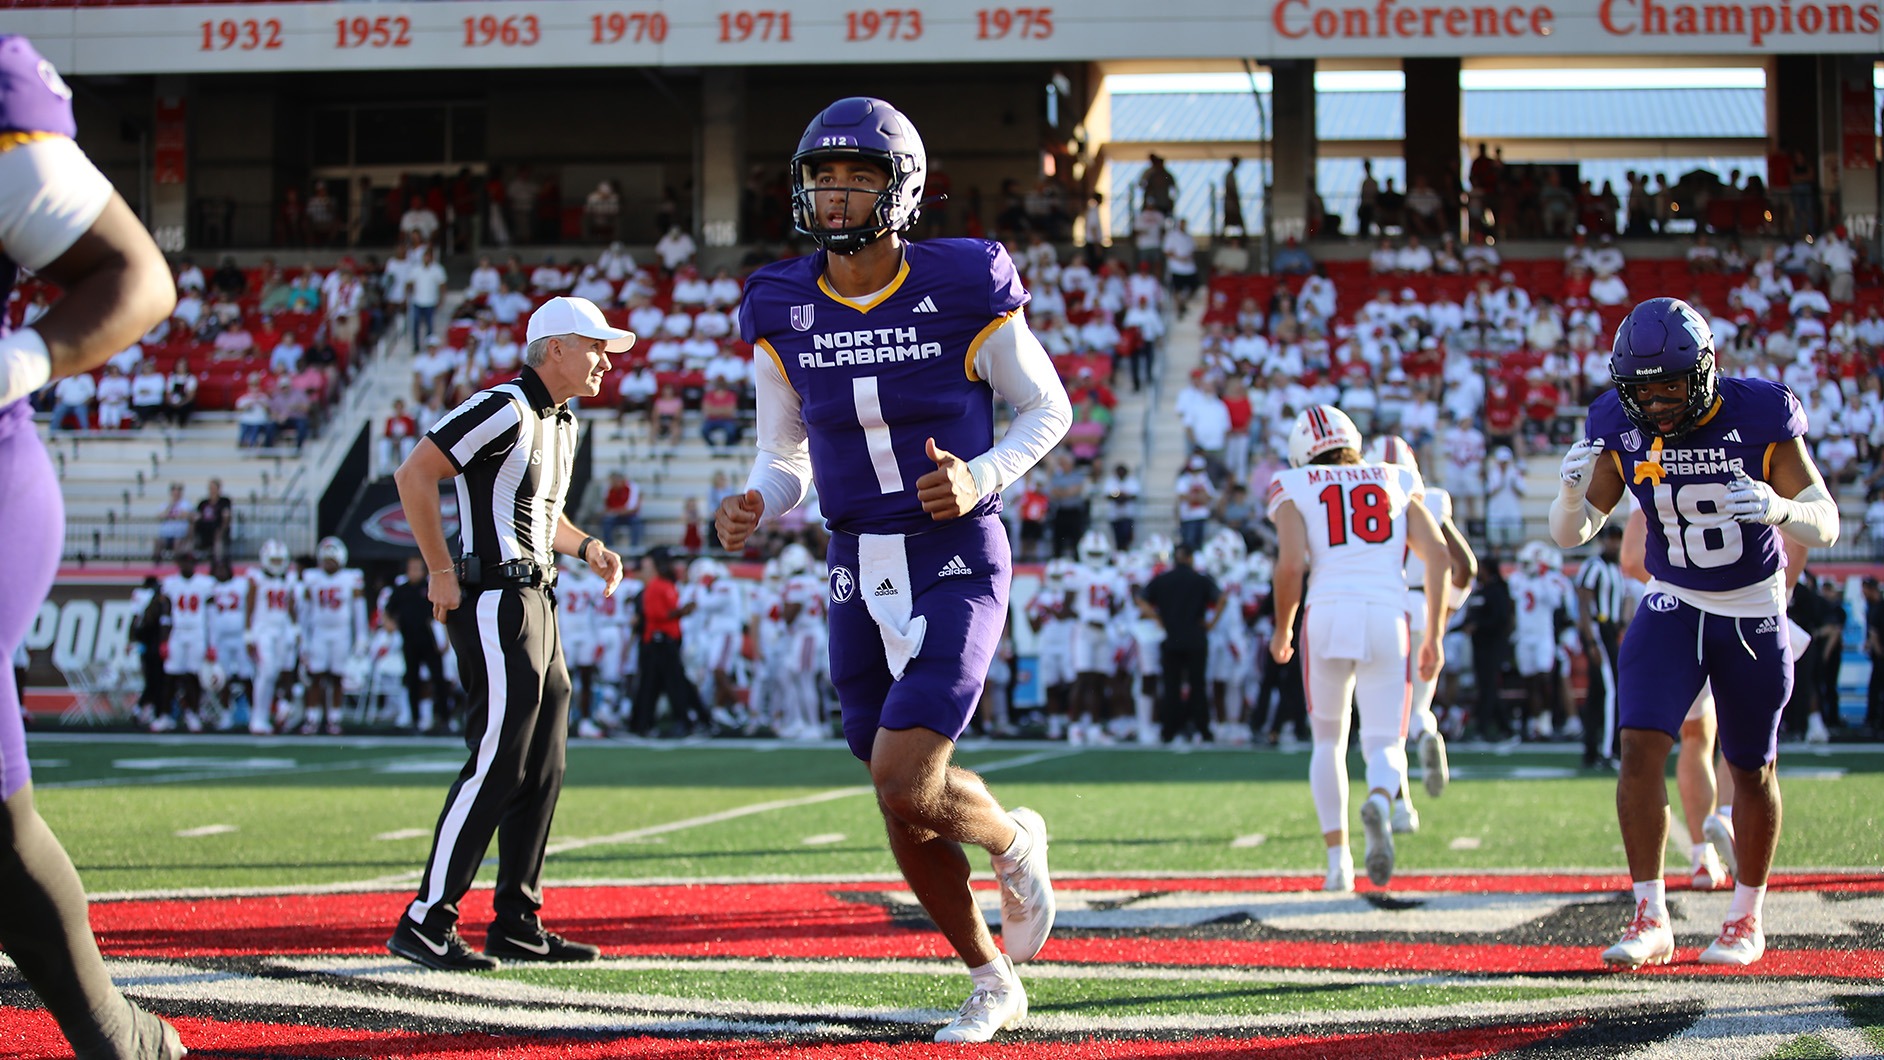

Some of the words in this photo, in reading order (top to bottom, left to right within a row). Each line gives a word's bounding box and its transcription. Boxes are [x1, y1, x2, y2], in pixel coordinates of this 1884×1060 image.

[199, 18, 284, 51] 1932
[334, 15, 412, 48] 1952
[462, 14, 541, 46] 1963
[591, 13, 668, 44] 1970
[717, 11, 793, 43] 1971
[844, 9, 924, 41] 1973
[975, 8, 1054, 40] 1975
[1272, 0, 1555, 39] Conference
[1600, 0, 1880, 46] Champions
[822, 136, 847, 147] 212
[813, 326, 917, 350] NORTH
[798, 342, 942, 368] ALABAMA
[1636, 366, 1663, 376] Riddell
[852, 376, 905, 495] 1
[530, 448, 542, 466] S
[1319, 483, 1393, 548] 18
[1653, 482, 1744, 569] 18
[937, 567, 973, 577] adidas
[874, 588, 899, 597] adidas
